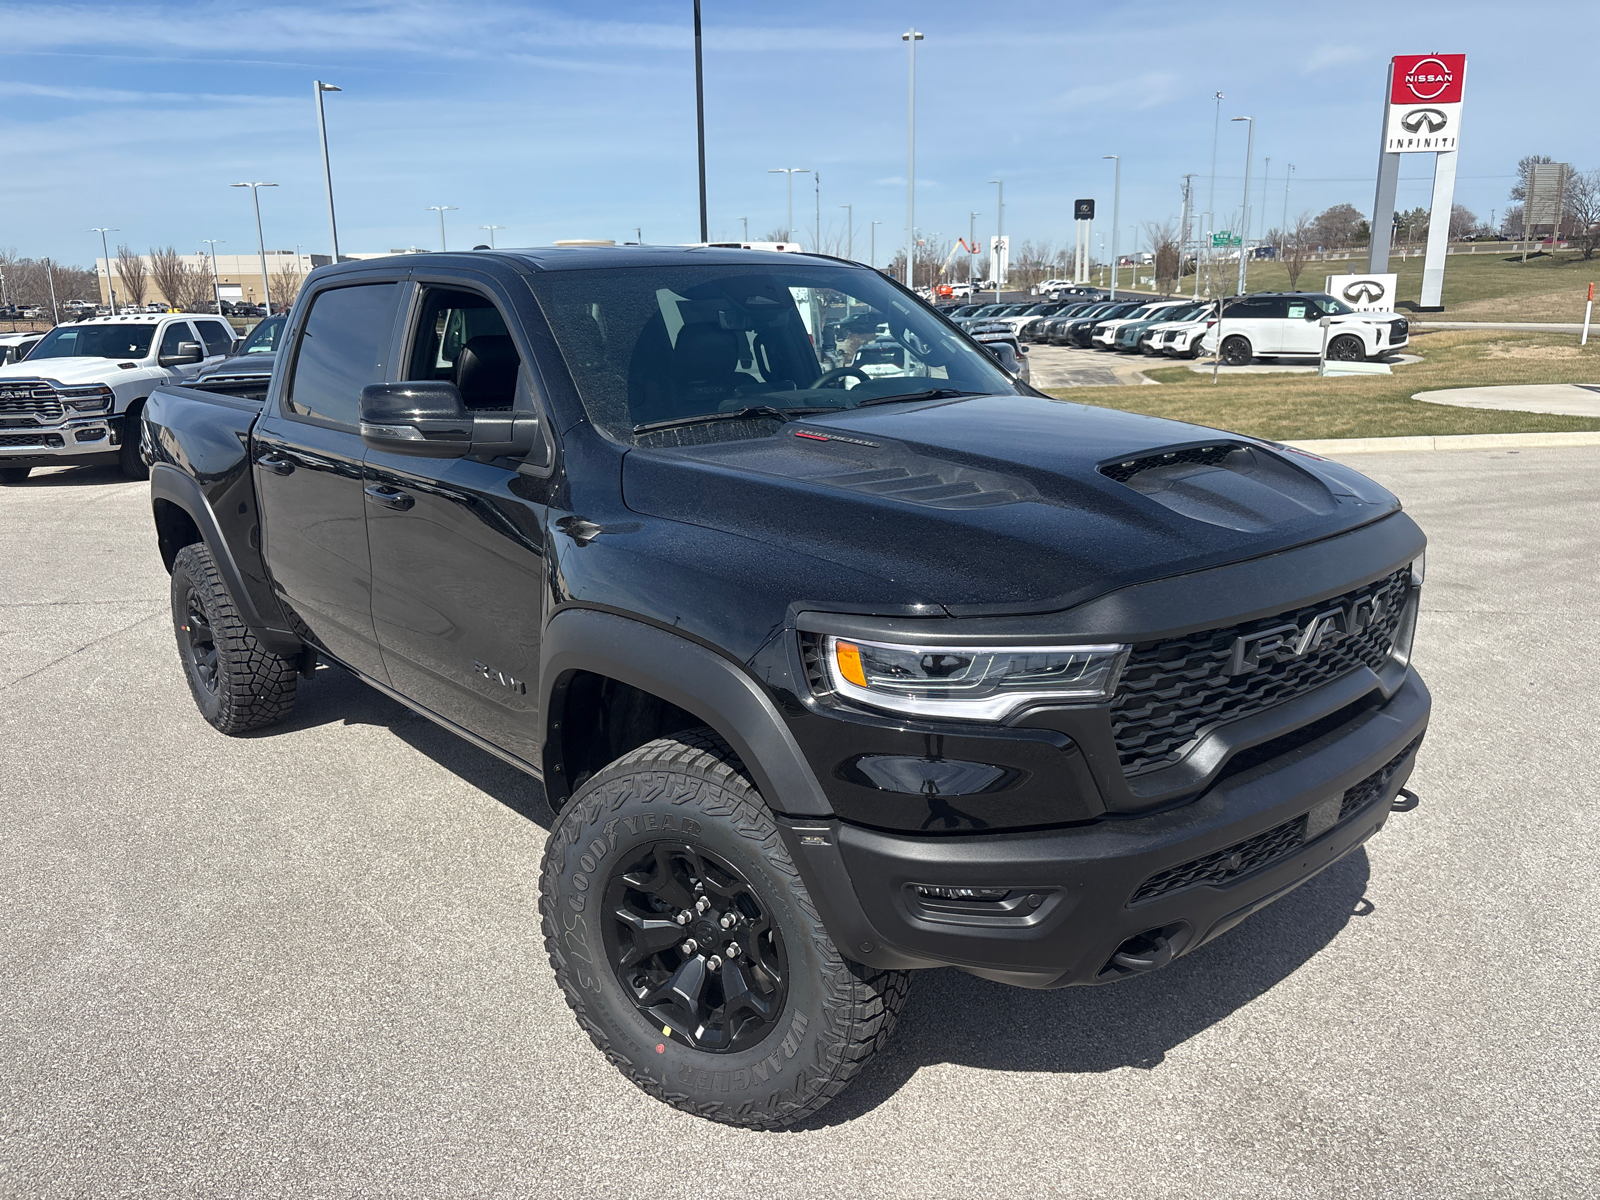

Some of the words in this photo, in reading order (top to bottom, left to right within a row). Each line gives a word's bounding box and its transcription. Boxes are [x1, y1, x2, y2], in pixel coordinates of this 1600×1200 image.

[1405, 74, 1453, 83] NISSAN
[1389, 137, 1455, 149] INFINITI
[1224, 584, 1391, 676] RAM
[471, 658, 527, 695] RAM
[567, 812, 703, 913] GOODYEAR
[676, 1007, 810, 1093] WRANGLER
